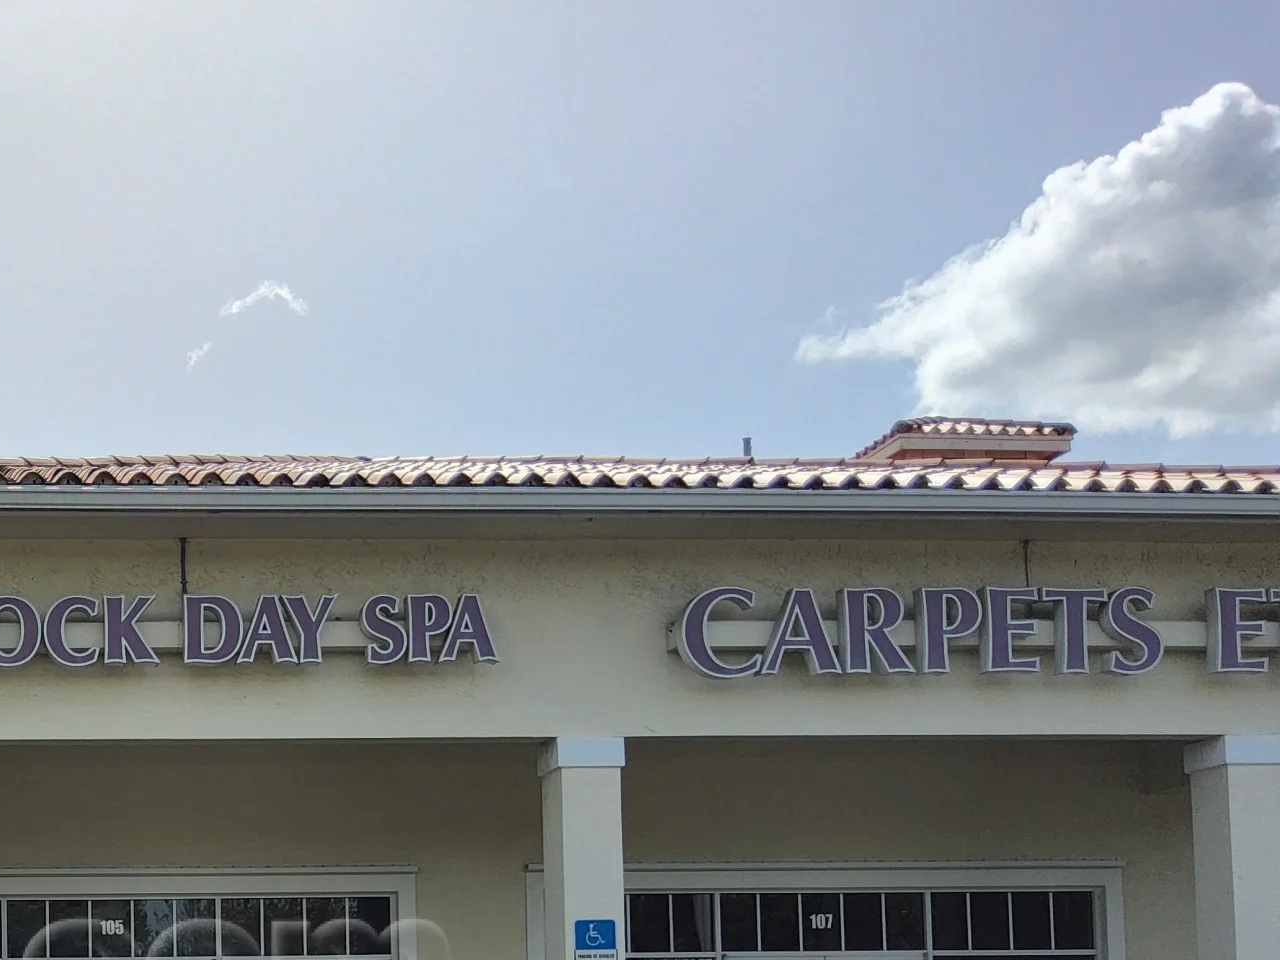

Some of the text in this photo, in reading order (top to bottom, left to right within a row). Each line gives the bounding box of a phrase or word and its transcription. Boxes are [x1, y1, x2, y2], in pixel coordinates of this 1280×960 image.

[182, 593, 340, 665] DAY
[362, 593, 499, 665] SPA
[679, 585, 1165, 678] CARPETS
[99, 919, 125, 936] 105
[809, 913, 833, 929] 107
